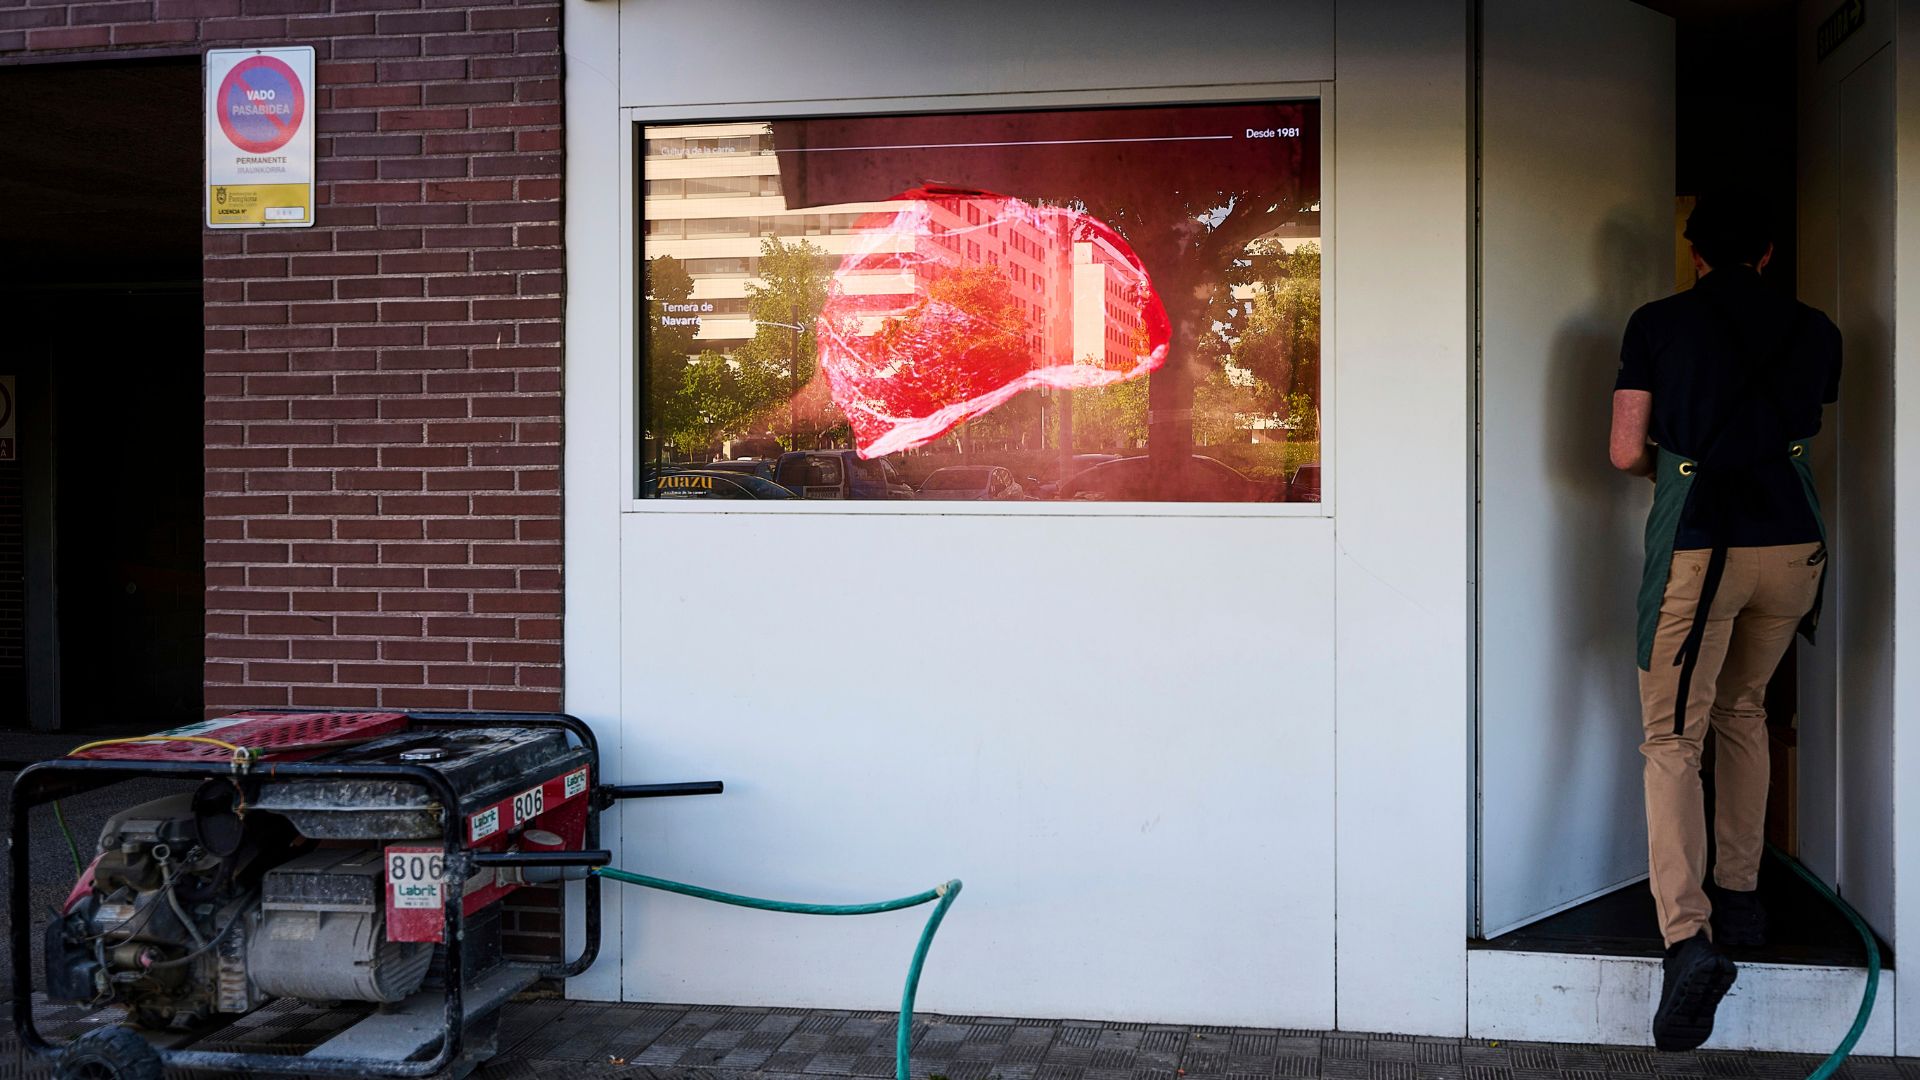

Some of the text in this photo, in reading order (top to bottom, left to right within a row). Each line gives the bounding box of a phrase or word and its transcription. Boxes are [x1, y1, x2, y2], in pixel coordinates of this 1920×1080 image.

[246, 89, 276, 101] VADO
[232, 104, 290, 116] PASABIDEA
[1246, 127, 1300, 138] Desde 1981
[661, 145, 736, 156] Cultura de la carne
[236, 156, 287, 165] PERMANENTE
[662, 301, 714, 312] Ternera de
[661, 315, 702, 326] Navarra
[567, 772, 585, 787] Labrit
[515, 789, 542, 821] 806
[474, 810, 496, 828] Labrit
[392, 855, 443, 881] 806
[399, 884, 437, 896] Labrit
